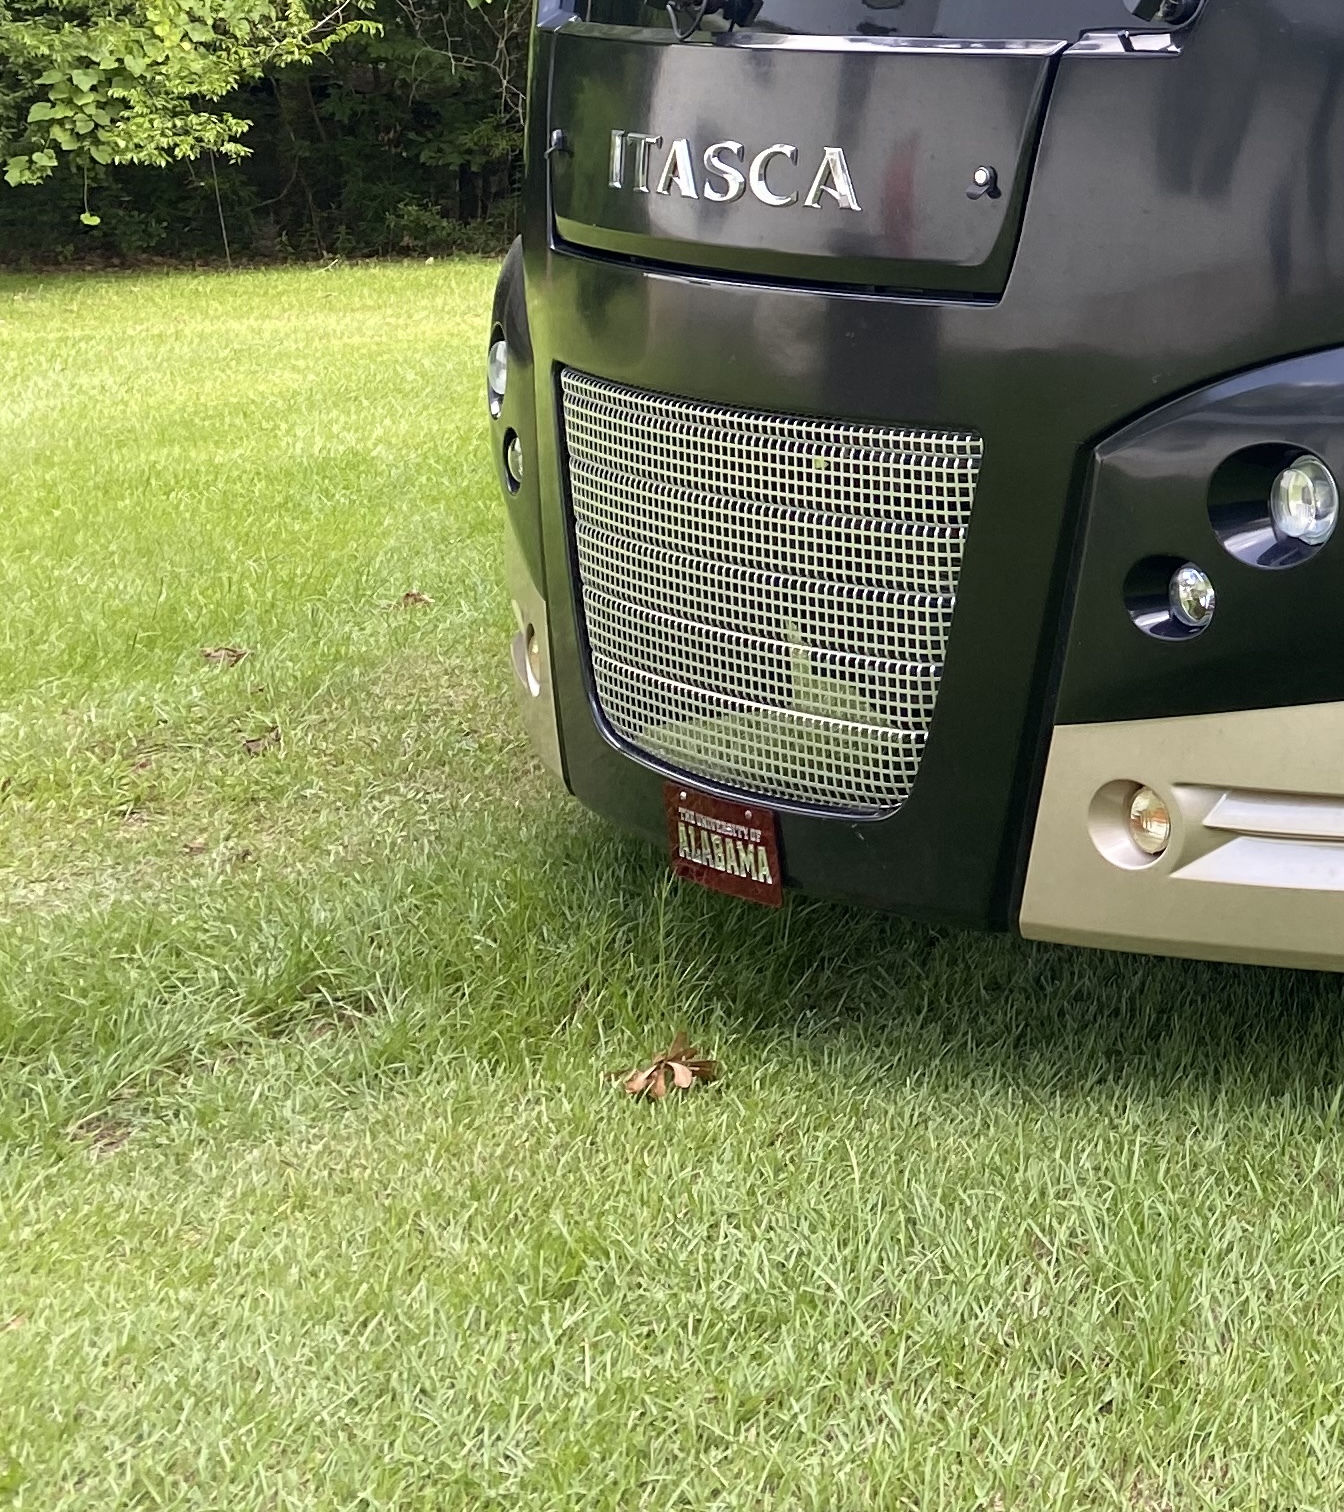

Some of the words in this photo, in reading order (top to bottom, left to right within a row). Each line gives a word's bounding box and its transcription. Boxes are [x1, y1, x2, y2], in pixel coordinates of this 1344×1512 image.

[608, 129, 863, 212] ITASCA
[678, 807, 696, 825] THE
[695, 813, 749, 841] UNIVERSITY
[750, 828, 762, 843] OF
[678, 822, 773, 885] ALABAMA
